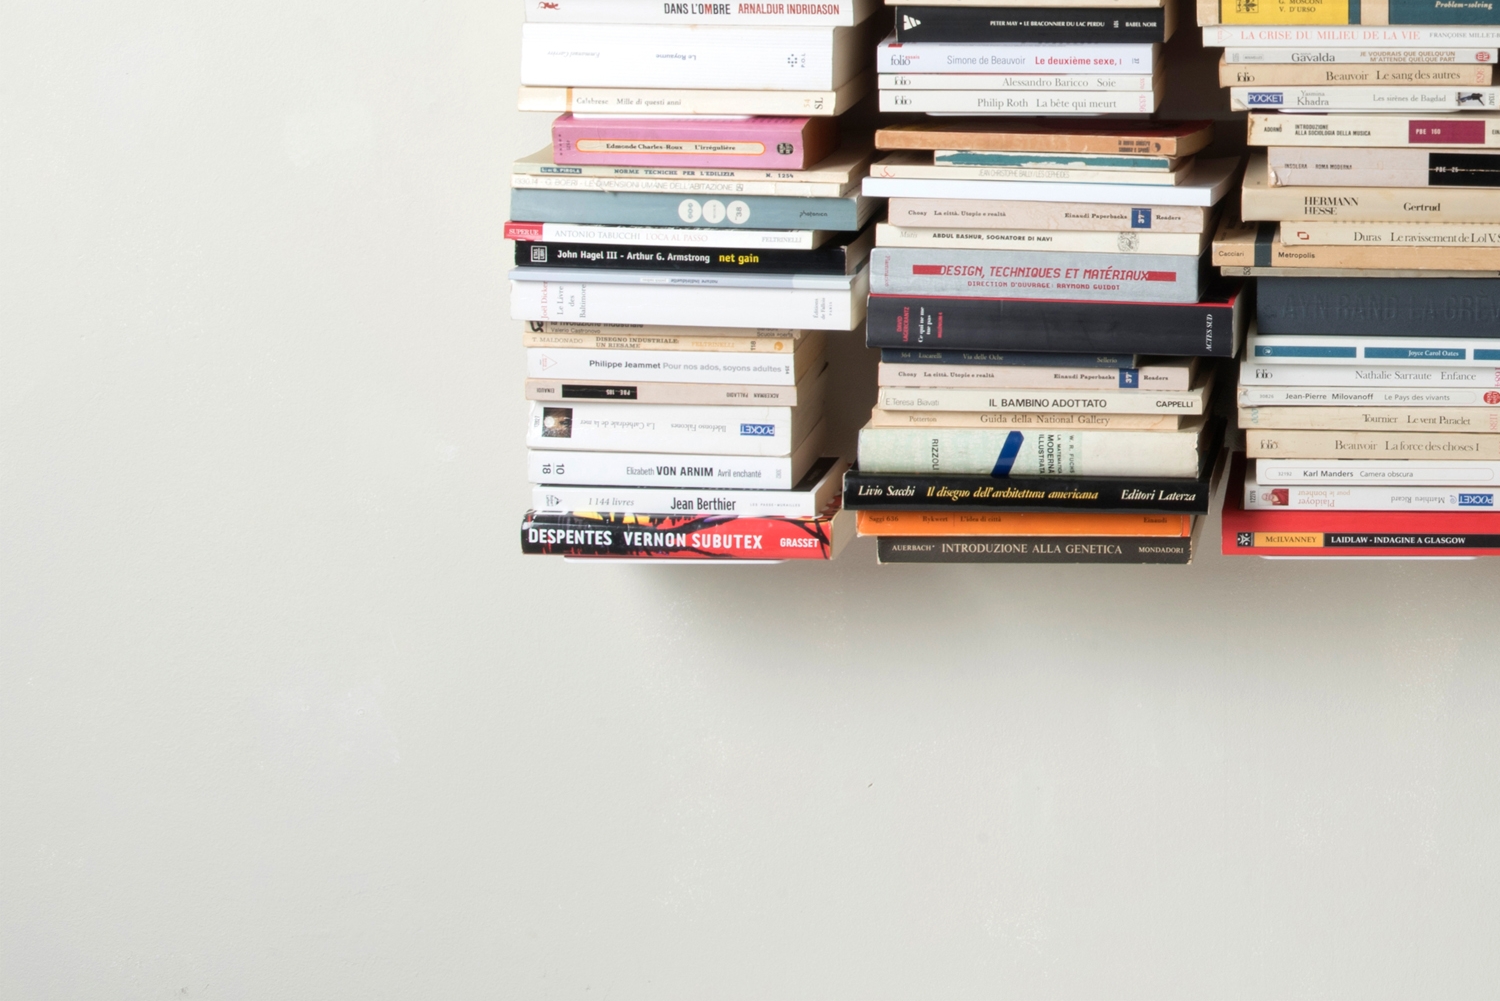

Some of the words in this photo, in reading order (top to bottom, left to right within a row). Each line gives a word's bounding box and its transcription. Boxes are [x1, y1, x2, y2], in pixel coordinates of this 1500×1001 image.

[664, 2, 689, 15] DANS
[691, 3, 731, 16] L'OMBRE
[738, 3, 784, 15] ARNALDUR
[786, 4, 840, 16] INDRIDASON
[1304, 197, 1359, 206] HERMANN
[1304, 207, 1337, 215] HESSE
[1403, 202, 1441, 212] Gertrud
[719, 253, 736, 263] net
[738, 253, 759, 265] gain
[1278, 252, 1316, 260] Metropolis
[940, 266, 986, 279] DESIGN,
[989, 267, 1061, 279] TECHNIQUES
[1065, 268, 1079, 279] ET
[1083, 265, 1149, 281] MATÉRIAUX
[589, 360, 622, 370] Philippe
[624, 361, 661, 370] Jeammet
[1355, 371, 1392, 380] Nathalie
[1395, 371, 1432, 380] Sarraute
[1441, 372, 1477, 381] Enfance
[989, 398, 997, 408] IL
[1001, 398, 1050, 408] BAMBINO
[1052, 399, 1107, 408] ADOTTATO
[1155, 400, 1194, 408] CAPPELLI
[626, 466, 655, 476] Elizabeth
[656, 466, 677, 477] VON
[680, 466, 714, 477] ARNIM
[717, 469, 731, 478] Avril
[732, 469, 762, 478] enchanté
[670, 497, 694, 510] Jean
[697, 497, 737, 511] Berthier
[528, 528, 613, 546] DESPENTES
[624, 531, 687, 549] VERNON
[692, 533, 763, 549] SUBUTEX
[780, 539, 819, 548] GRASSET
[1331, 536, 1367, 544] LAIDLAW
[1374, 536, 1415, 545] INDAGINE
[1424, 536, 1466, 545] GLASGOW
[942, 544, 1028, 554] INTRODUZIONE
[1032, 544, 1061, 554] ALLA
[1065, 544, 1122, 555] GENETICA
